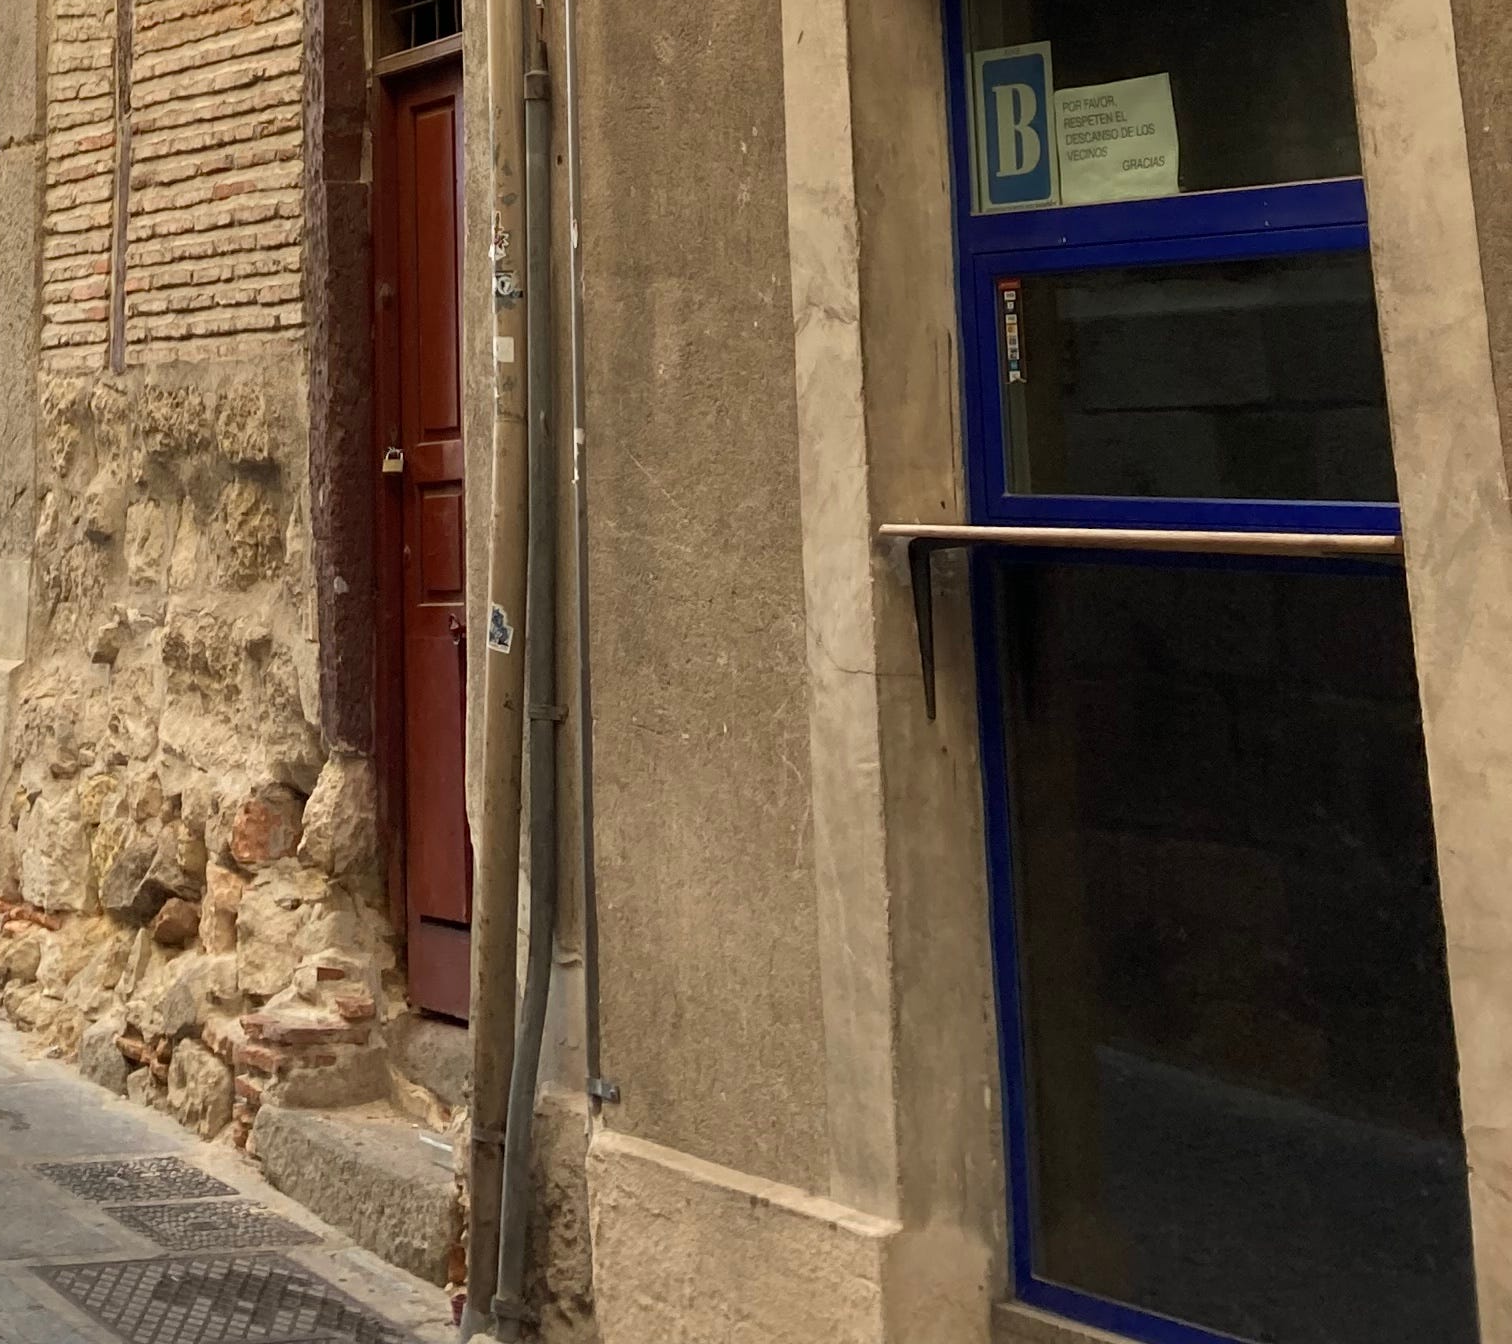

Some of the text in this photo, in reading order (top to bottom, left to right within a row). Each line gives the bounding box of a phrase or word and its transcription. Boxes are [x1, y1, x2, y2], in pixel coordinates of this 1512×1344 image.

[1062, 100, 1082, 112] POR
[1064, 111, 1128, 129] RESPETEN EL
[992, 82, 1041, 178] B
[1065, 123, 1155, 145] DESCANSO DE LOS
[1066, 146, 1108, 162] VECINOS
[1122, 155, 1166, 171] GRACIAS
